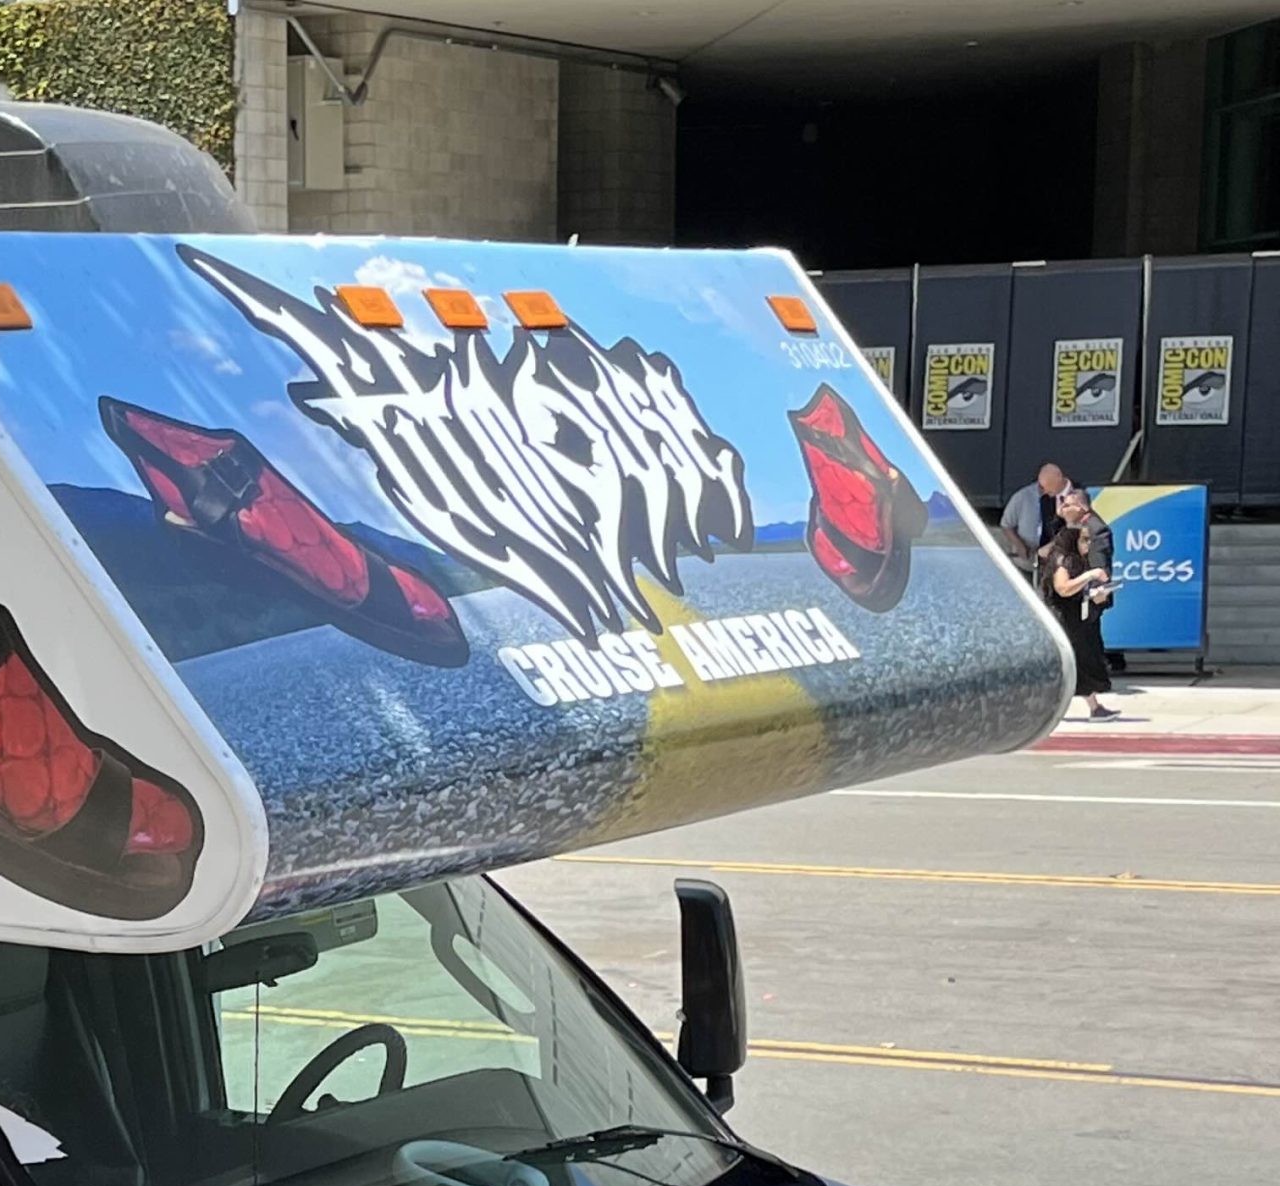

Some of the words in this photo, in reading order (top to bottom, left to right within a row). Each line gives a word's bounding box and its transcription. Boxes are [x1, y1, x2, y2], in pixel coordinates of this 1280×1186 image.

[949, 355, 989, 375] CON
[1078, 351, 1118, 371] CON
[1185, 348, 1227, 369] CON
[926, 355, 950, 416] COMIC
[1055, 351, 1078, 415] COMIC
[1161, 347, 1186, 411] COMIC
[1125, 529, 1162, 552] NO
[1112, 560, 1194, 582] CCESS
[498, 630, 684, 706] CRUISE
[668, 607, 861, 682] AMERICA
